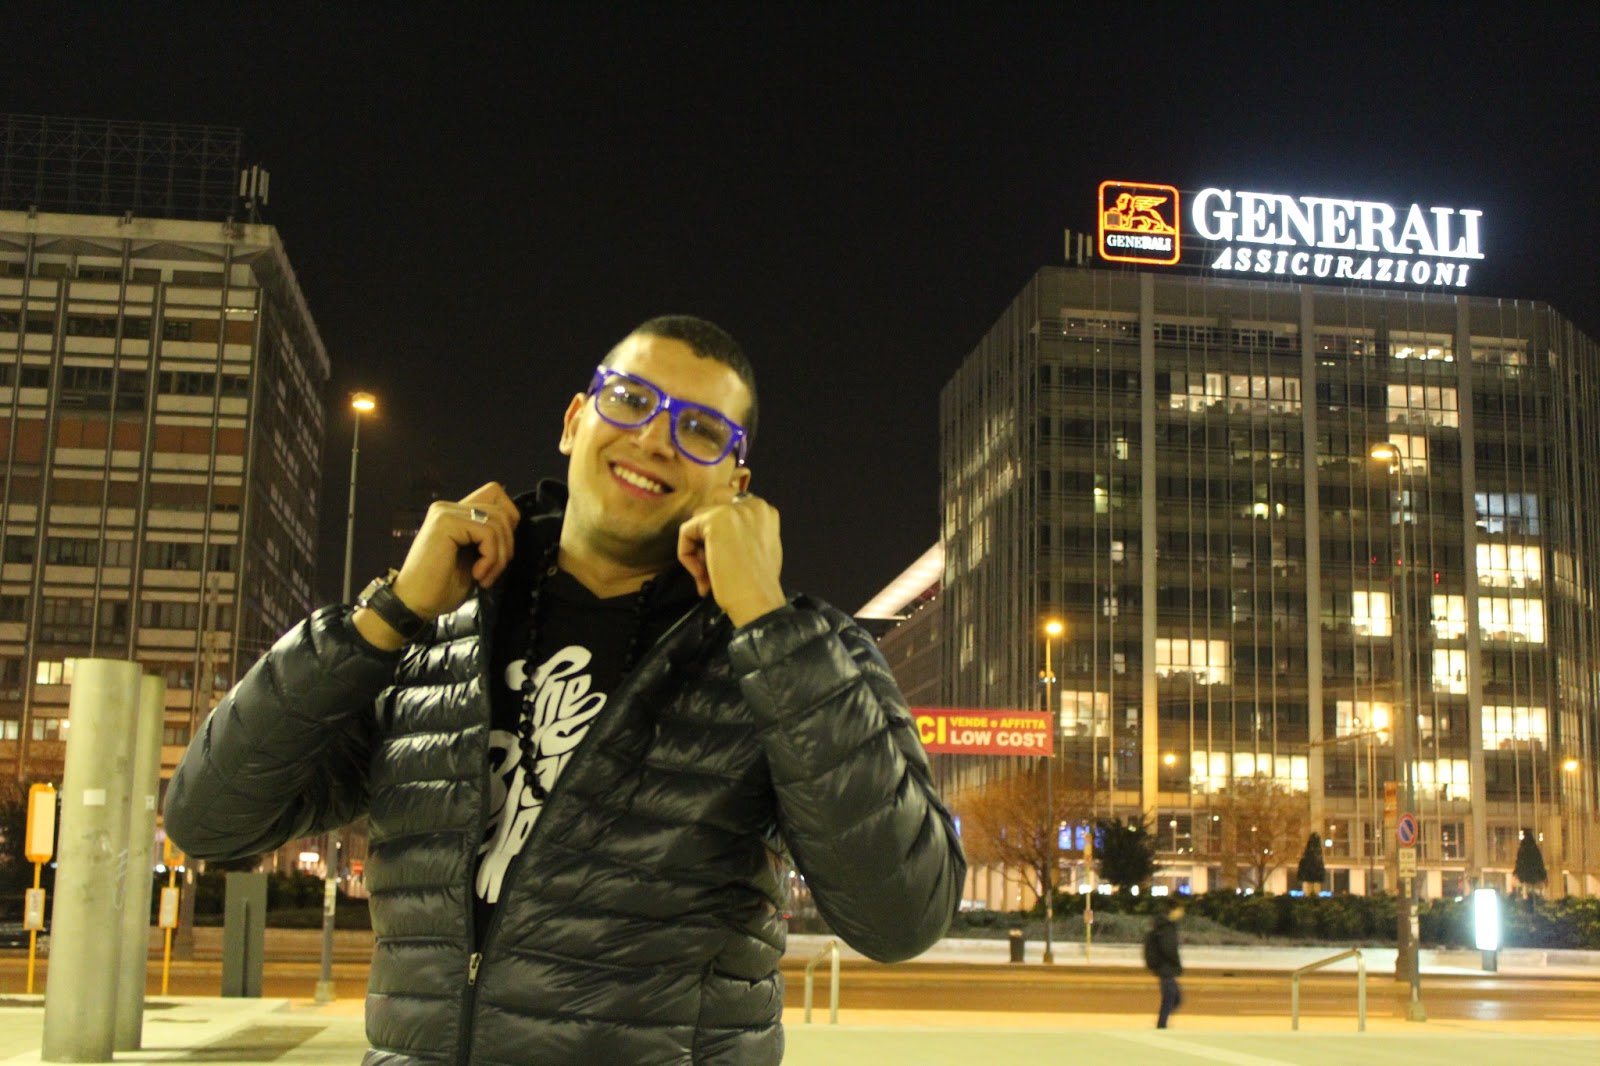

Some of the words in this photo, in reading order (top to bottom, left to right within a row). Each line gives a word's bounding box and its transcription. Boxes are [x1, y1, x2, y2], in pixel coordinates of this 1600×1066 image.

[1191, 187, 1485, 260] GENERALI
[1106, 234, 1171, 251] GENERALI
[1212, 247, 1471, 288] ASSICURAZIONI
[950, 716, 988, 728] VENDE
[999, 718, 1047, 729] AFFITTA
[950, 730, 992, 745] LOW
[996, 732, 1047, 747] COST
